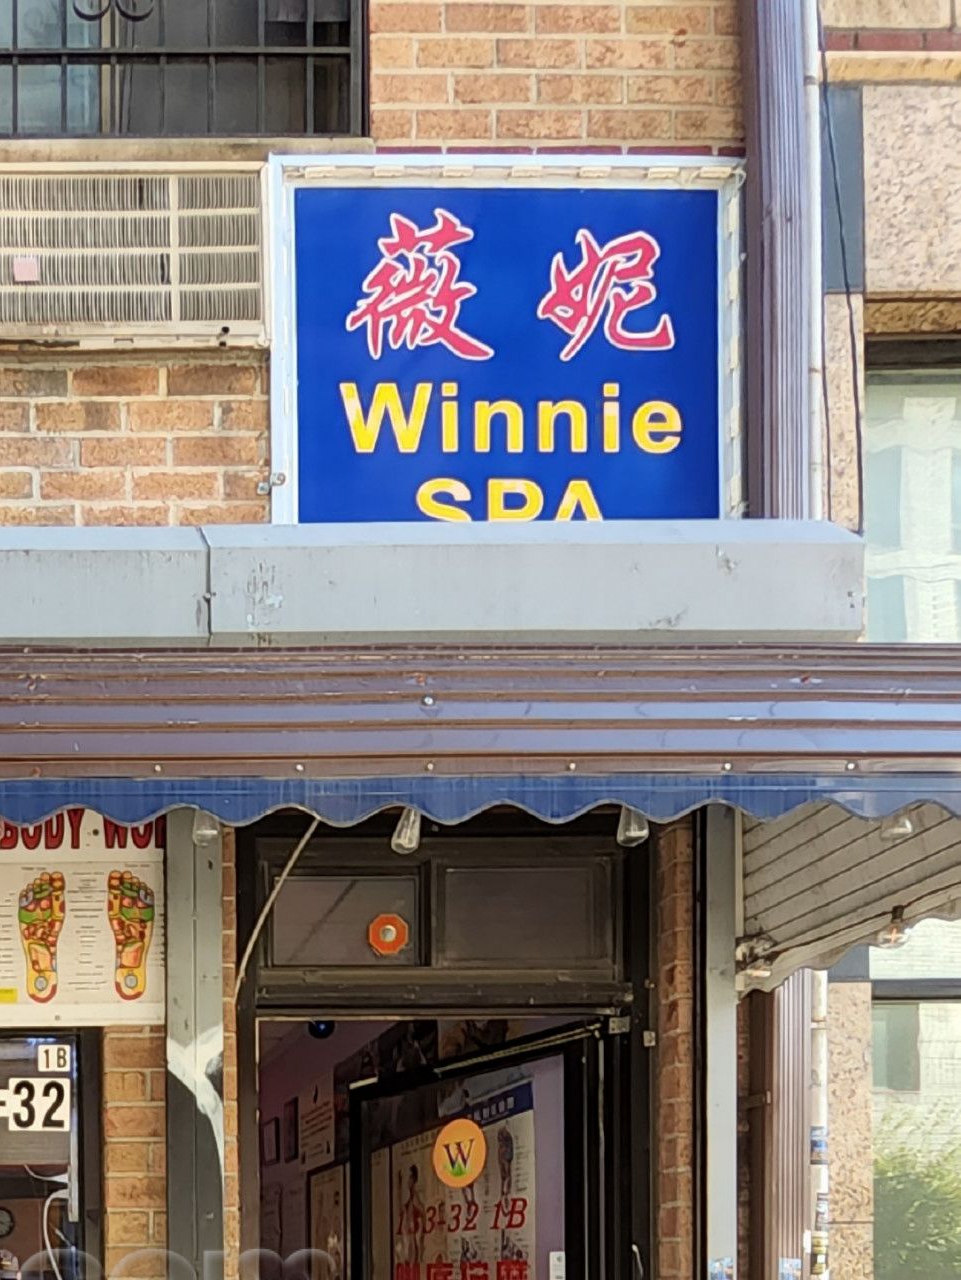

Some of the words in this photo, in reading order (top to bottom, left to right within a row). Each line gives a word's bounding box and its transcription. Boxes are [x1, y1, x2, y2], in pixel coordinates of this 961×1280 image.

[346, 207, 676, 362] 薇妮
[339, 381, 684, 454] Winnie
[415, 477, 604, 521] SPA
[42, 1046, 68, 1069] 1B
[442, 1137, 476, 1170] W
[489, 1197, 529, 1231] 1B
